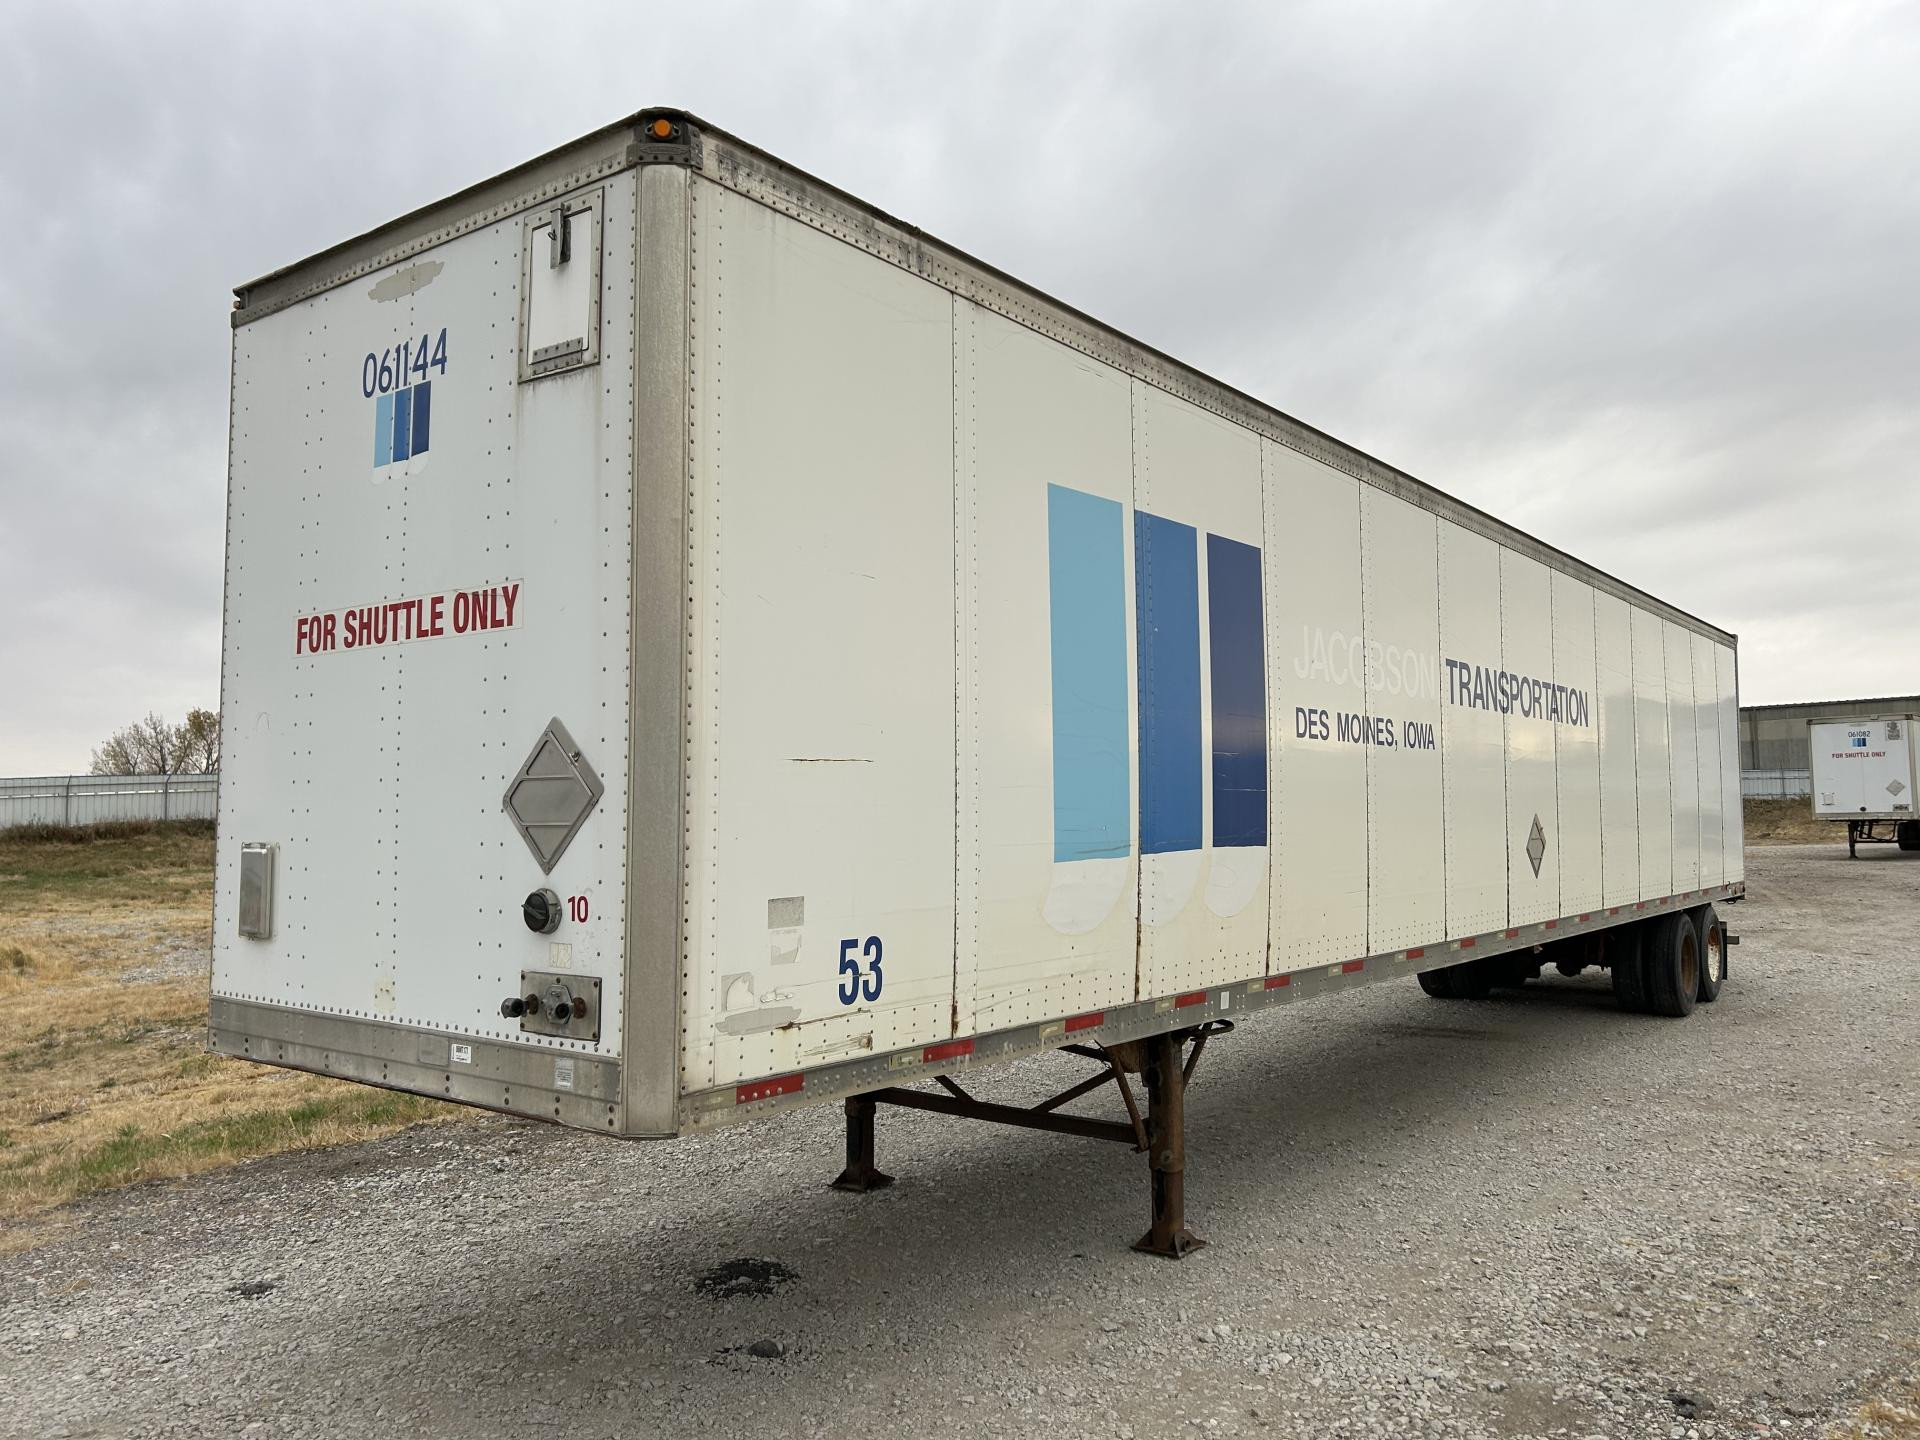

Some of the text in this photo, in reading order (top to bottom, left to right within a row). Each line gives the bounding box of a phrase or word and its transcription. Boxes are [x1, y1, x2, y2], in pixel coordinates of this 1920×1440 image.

[363, 328, 447, 398] 061144
[296, 584, 520, 654] FOR SHUTTLE ONLY
[1293, 625, 1589, 727] JACOBSON TRANSPORTATION
[1295, 706, 1436, 751] DES MOINES, IOWA
[1844, 751, 1870, 759] SHUTTLE
[1847, 730, 1871, 738] 061082
[567, 895, 589, 923] 10
[838, 935, 883, 1005] 53
